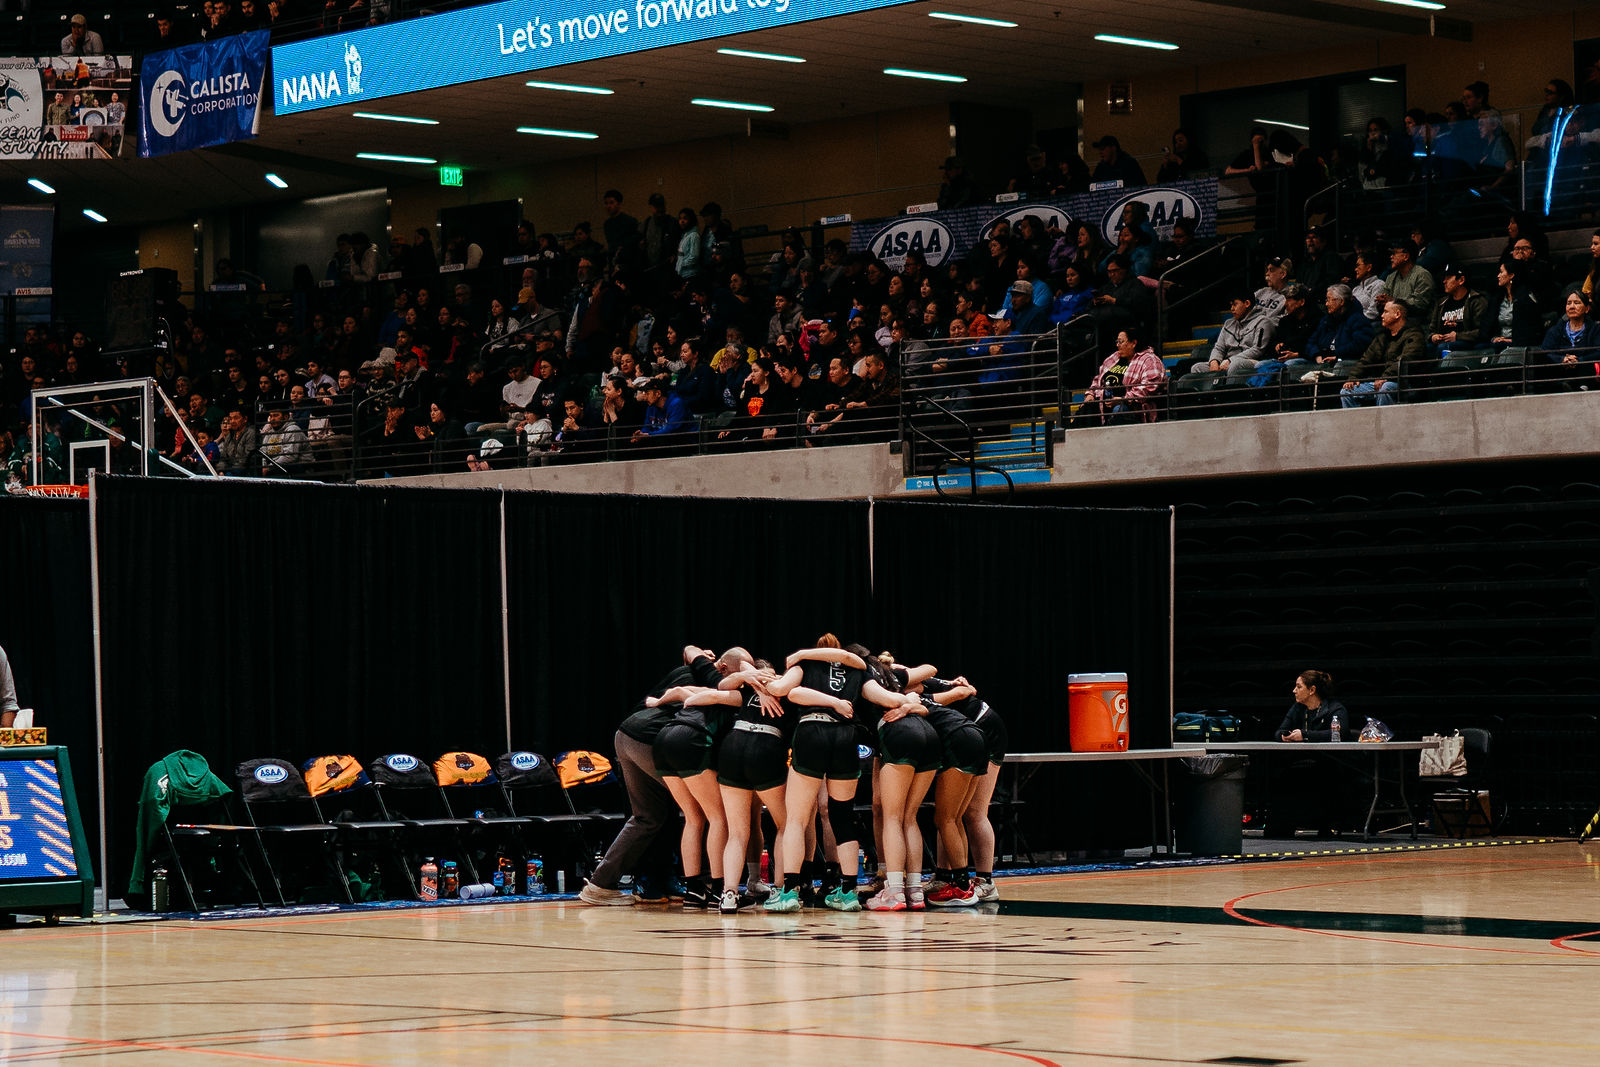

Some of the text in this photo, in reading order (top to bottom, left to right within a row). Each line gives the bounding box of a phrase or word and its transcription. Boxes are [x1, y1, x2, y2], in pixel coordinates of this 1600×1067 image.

[498, 16, 552, 54] Let's
[558, 9, 629, 44] move
[190, 72, 250, 99] CALISTA
[283, 69, 342, 107] NANA
[191, 93, 260, 115] CORPORATION
[444, 168, 461, 185] EXIT
[908, 205, 921, 213] AVIS
[878, 228, 942, 259] ASAA
[830, 665, 846, 691] 5
[1114, 693, 1127, 714] G
[392, 757, 413, 766] ASAA
[516, 756, 534, 764] ASAA
[260, 769, 282, 777] ASAA
[423, 885, 438, 897] YETI
